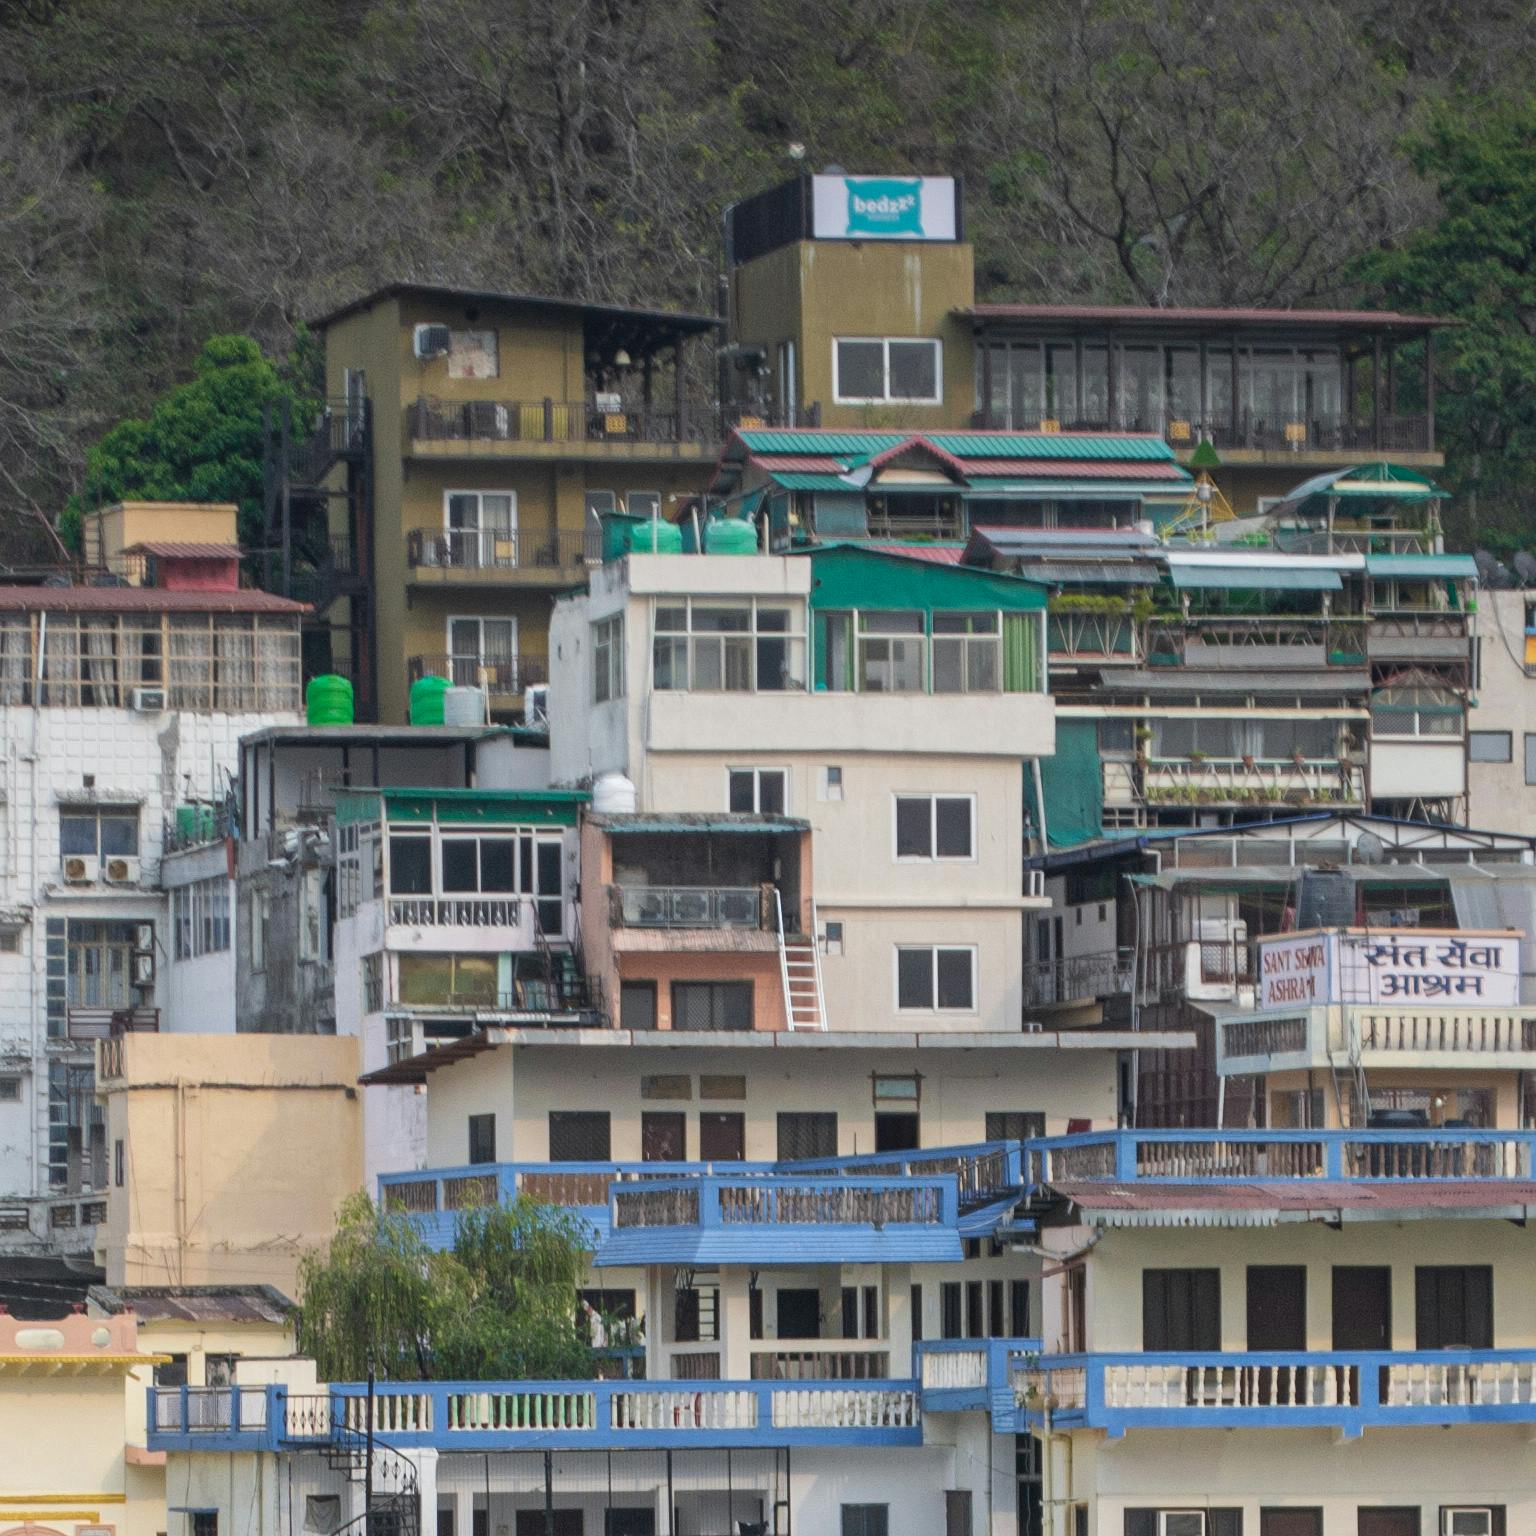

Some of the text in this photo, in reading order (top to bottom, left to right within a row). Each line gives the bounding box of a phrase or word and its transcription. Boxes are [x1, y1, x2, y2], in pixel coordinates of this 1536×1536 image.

[1264, 950, 1293, 975] SANT
[1365, 936, 1429, 968] संत
[1379, 972, 1485, 998] आश्रम
